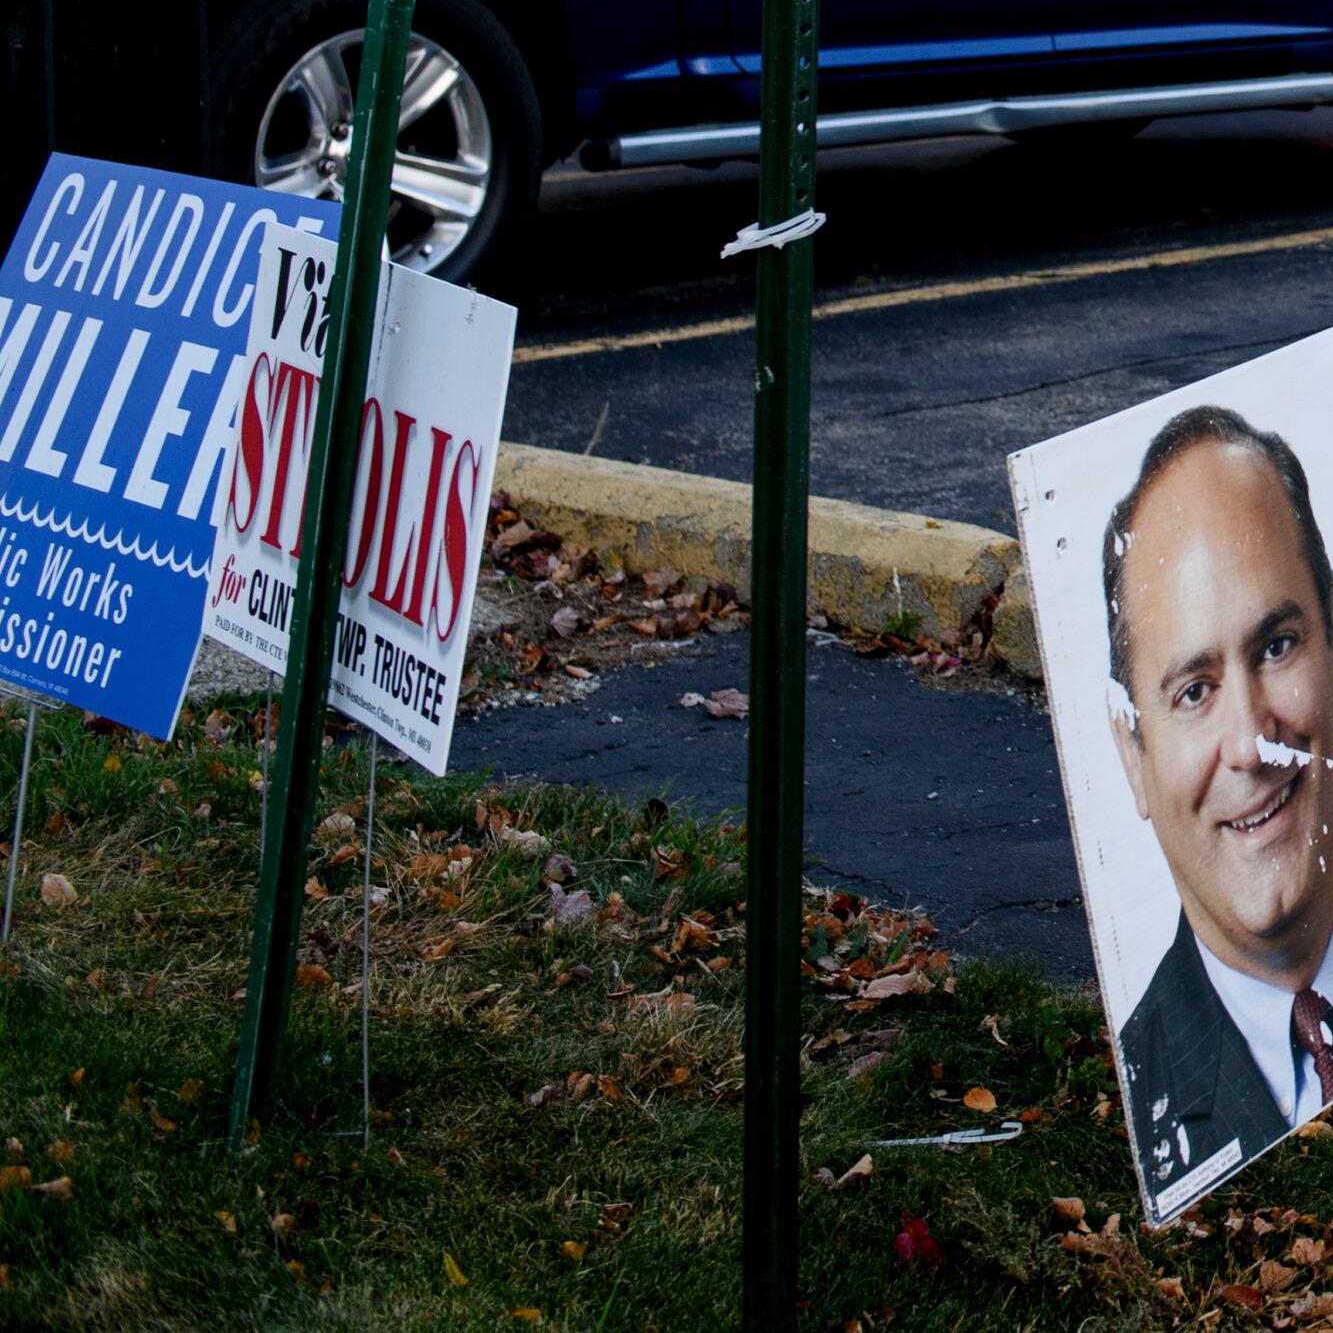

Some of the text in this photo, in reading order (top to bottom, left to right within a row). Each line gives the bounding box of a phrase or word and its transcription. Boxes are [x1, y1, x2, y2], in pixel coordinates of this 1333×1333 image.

[24, 172, 324, 328] CANDIC
[225, 351, 483, 643] STOLIS
[36, 542, 133, 624] Works
[212, 554, 246, 608] for
[248, 569, 297, 632] CLIN
[372, 633, 447, 726] TRUSTEE
[214, 615, 231, 632] PAID
[231, 622, 244, 640] FOR
